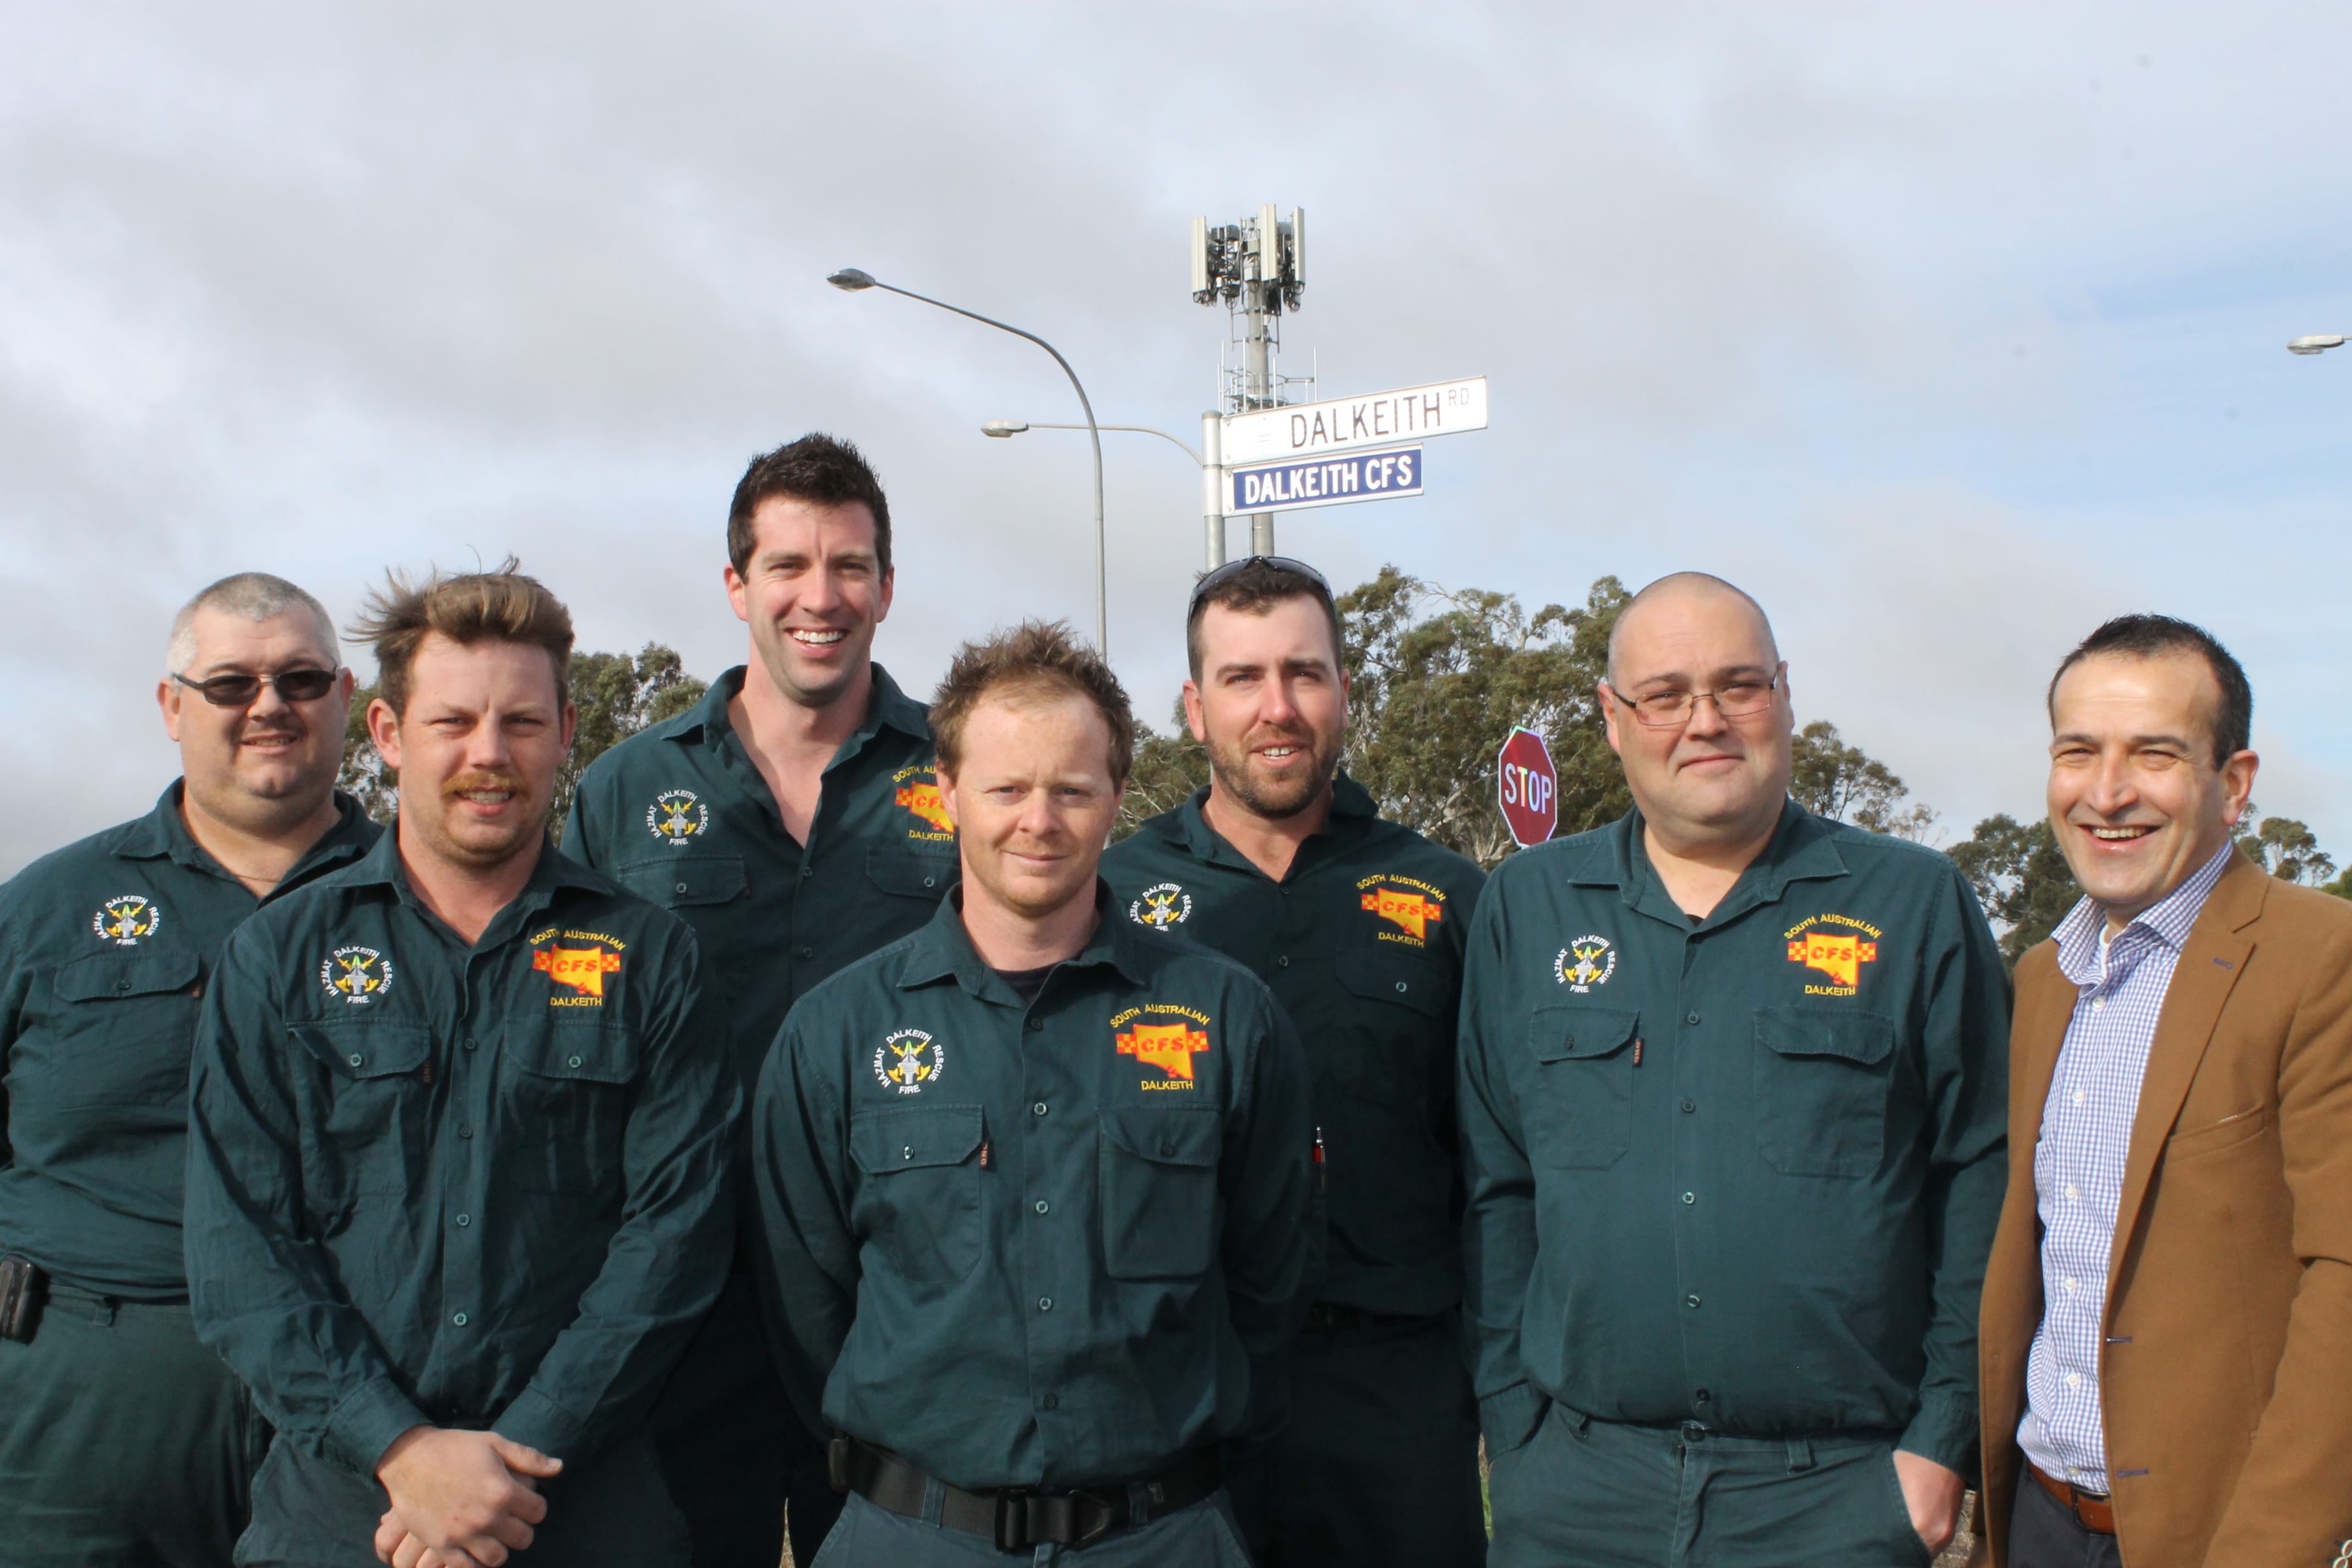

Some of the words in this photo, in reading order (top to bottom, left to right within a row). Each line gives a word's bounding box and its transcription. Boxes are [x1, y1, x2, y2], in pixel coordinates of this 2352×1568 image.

[1291, 391, 1441, 448] DALKEITH
[1448, 388, 1469, 407] RD
[1244, 462, 1358, 504] DALKEITH
[1365, 455, 1413, 491] CFS
[892, 766, 920, 782] SOUTH
[657, 790, 698, 803] DALKEITH
[1505, 763, 1552, 814] STOP
[916, 794, 945, 809] CF
[646, 804, 662, 838] HAZMAT
[694, 804, 709, 836] RESCUE
[669, 837, 688, 846] FIRE
[909, 830, 954, 842] DALKEITH
[1142, 883, 1182, 899] DALKEITH
[1356, 874, 1386, 890] SOUTH
[1389, 874, 1447, 902] AUSTRALIAN
[105, 895, 148, 908] DALKEITH
[1177, 894, 1191, 923] RESCUE
[1382, 901, 1419, 916] CFS
[93, 911, 110, 939] HAZMAT
[144, 906, 160, 936] RESCUE
[1783, 916, 1817, 939] SOUTH
[1820, 913, 1882, 939] AUSTRALIAN
[563, 929, 626, 951] AUSTRALIAN
[1378, 932, 1424, 948] DALKEITH
[1571, 934, 1610, 948] DALKEITH
[333, 946, 380, 959] DALKEITH
[1810, 946, 1853, 962] CFS
[555, 960, 597, 973] CFS
[1554, 948, 1568, 984] HAZMAT
[1597, 950, 1616, 984] RESCUE
[320, 960, 340, 997] HAZMAT
[377, 960, 393, 994] RESCUE
[1569, 984, 1589, 993] FIRE
[1804, 984, 1856, 996] DALKEITH
[346, 995, 369, 1004] FIRE
[550, 997, 602, 1006] DALKEITH
[1110, 1007, 1141, 1028] SOUTH
[1145, 1004, 1210, 1026] AUSTRALIAN
[885, 1028, 933, 1044] DALKEITH
[1141, 1037, 1184, 1053] CFS
[873, 1047, 891, 1088] HAZMAT
[928, 1044, 944, 1082] RESCUE
[898, 1084, 921, 1095] FIRE
[1141, 1080, 1194, 1091] DALKEITH
